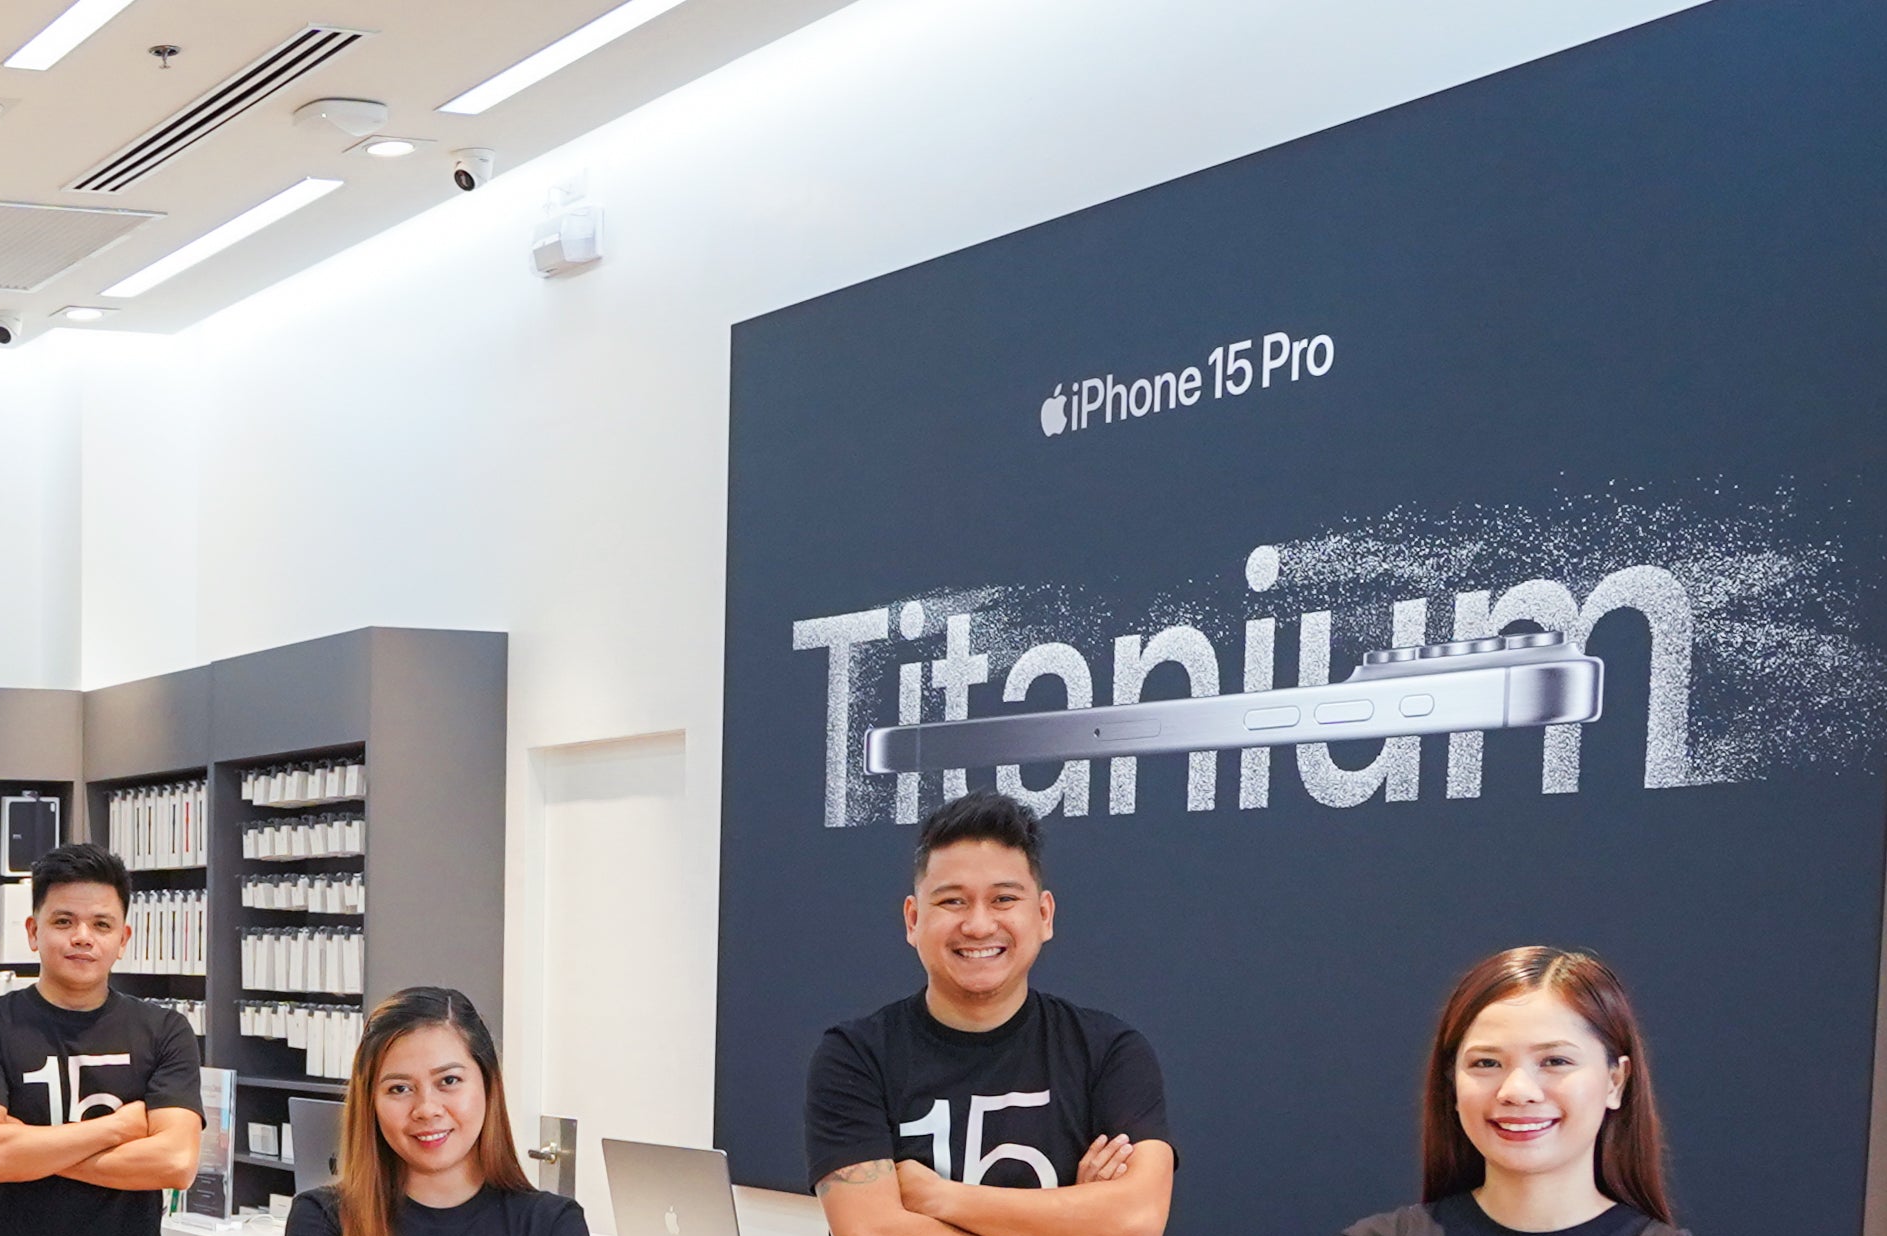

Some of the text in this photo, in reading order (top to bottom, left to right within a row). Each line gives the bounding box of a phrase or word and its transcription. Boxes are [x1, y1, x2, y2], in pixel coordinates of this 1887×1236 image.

[1070, 331, 1335, 431] iPhone 15 Pro
[792, 544, 1695, 828] Titanium
[22, 1053, 131, 1127] 15
[899, 1089, 1059, 1190] 15
